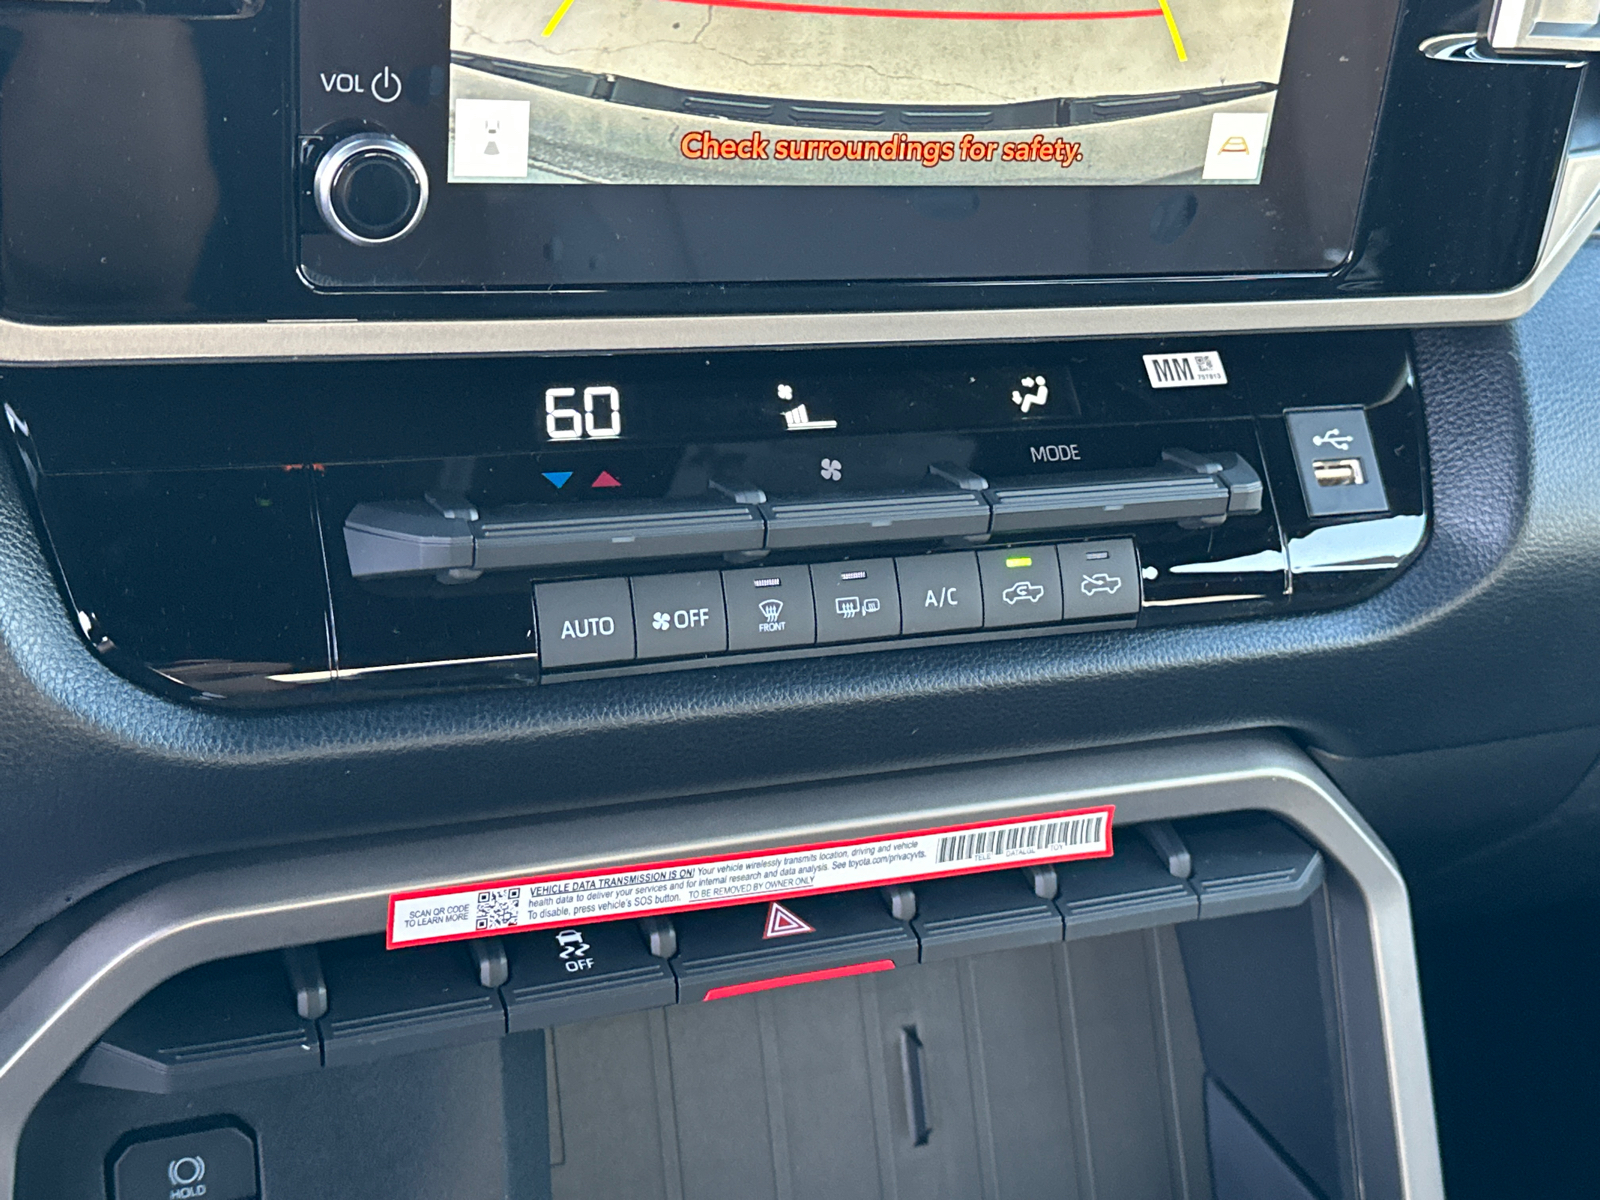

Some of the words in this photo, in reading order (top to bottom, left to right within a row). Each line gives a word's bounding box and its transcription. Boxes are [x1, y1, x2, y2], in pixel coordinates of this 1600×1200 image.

[320, 73, 364, 93] VOL
[680, 131, 769, 160] Check
[774, 134, 954, 167] surroundings
[958, 135, 1000, 162] for
[1001, 135, 1083, 168] safety.
[1151, 357, 1195, 382] MM
[545, 386, 621, 439] 60
[1029, 443, 1082, 463] MODE
[924, 587, 959, 608] A/C
[561, 616, 615, 640] AUTO
[673, 607, 709, 629] OFF
[758, 620, 786, 633] FRONT
[530, 883, 570, 896] VEHICLE
[572, 879, 597, 892] DATA
[598, 871, 667, 888] TRANSMISSION
[668, 869, 678, 879] IS
[697, 866, 716, 876] Your
[717, 862, 744, 873] vehicle
[745, 857, 782, 870] wirelessly
[783, 853, 818, 866] transmits
[818, 849, 849, 861] location,
[851, 846, 876, 857] driving
[877, 843, 892, 853] and
[893, 840, 919, 851] vehicle
[528, 896, 554, 908] health
[555, 895, 574, 905] data
[576, 893, 585, 902] to
[586, 889, 614, 900] deliver
[615, 887, 634, 899] your
[634, 883, 668, 895] services
[669, 881, 685, 891] and
[686, 879, 698, 889] for
[698, 875, 727, 887] internal
[728, 871, 762, 883] research
[763, 869, 778, 879] and
[779, 867, 797, 877] data
[797, 863, 829, 875] analysis.
[831, 860, 847, 870] See
[528, 909, 538, 920] To
[540, 906, 571, 918] disable,
[573, 903, 596, 916] press
[598, 899, 632, 911] vehicle's
[634, 895, 653, 907] SOS
[655, 892, 681, 904] button.
[689, 890, 700, 899] TO
[701, 888, 711, 898] BE
[713, 883, 752, 896] REMOVED
[753, 881, 764, 891] BY
[765, 878, 794, 890] OWNER
[795, 875, 816, 886] ONLY
[404, 919, 416, 928] TO
[417, 916, 444, 927] LEARN
[445, 912, 469, 923] MORE
[409, 909, 432, 919] SCAN
[447, 904, 470, 914] CODE
[564, 957, 595, 973] OFF
[169, 1184, 207, 1200] HOLD
